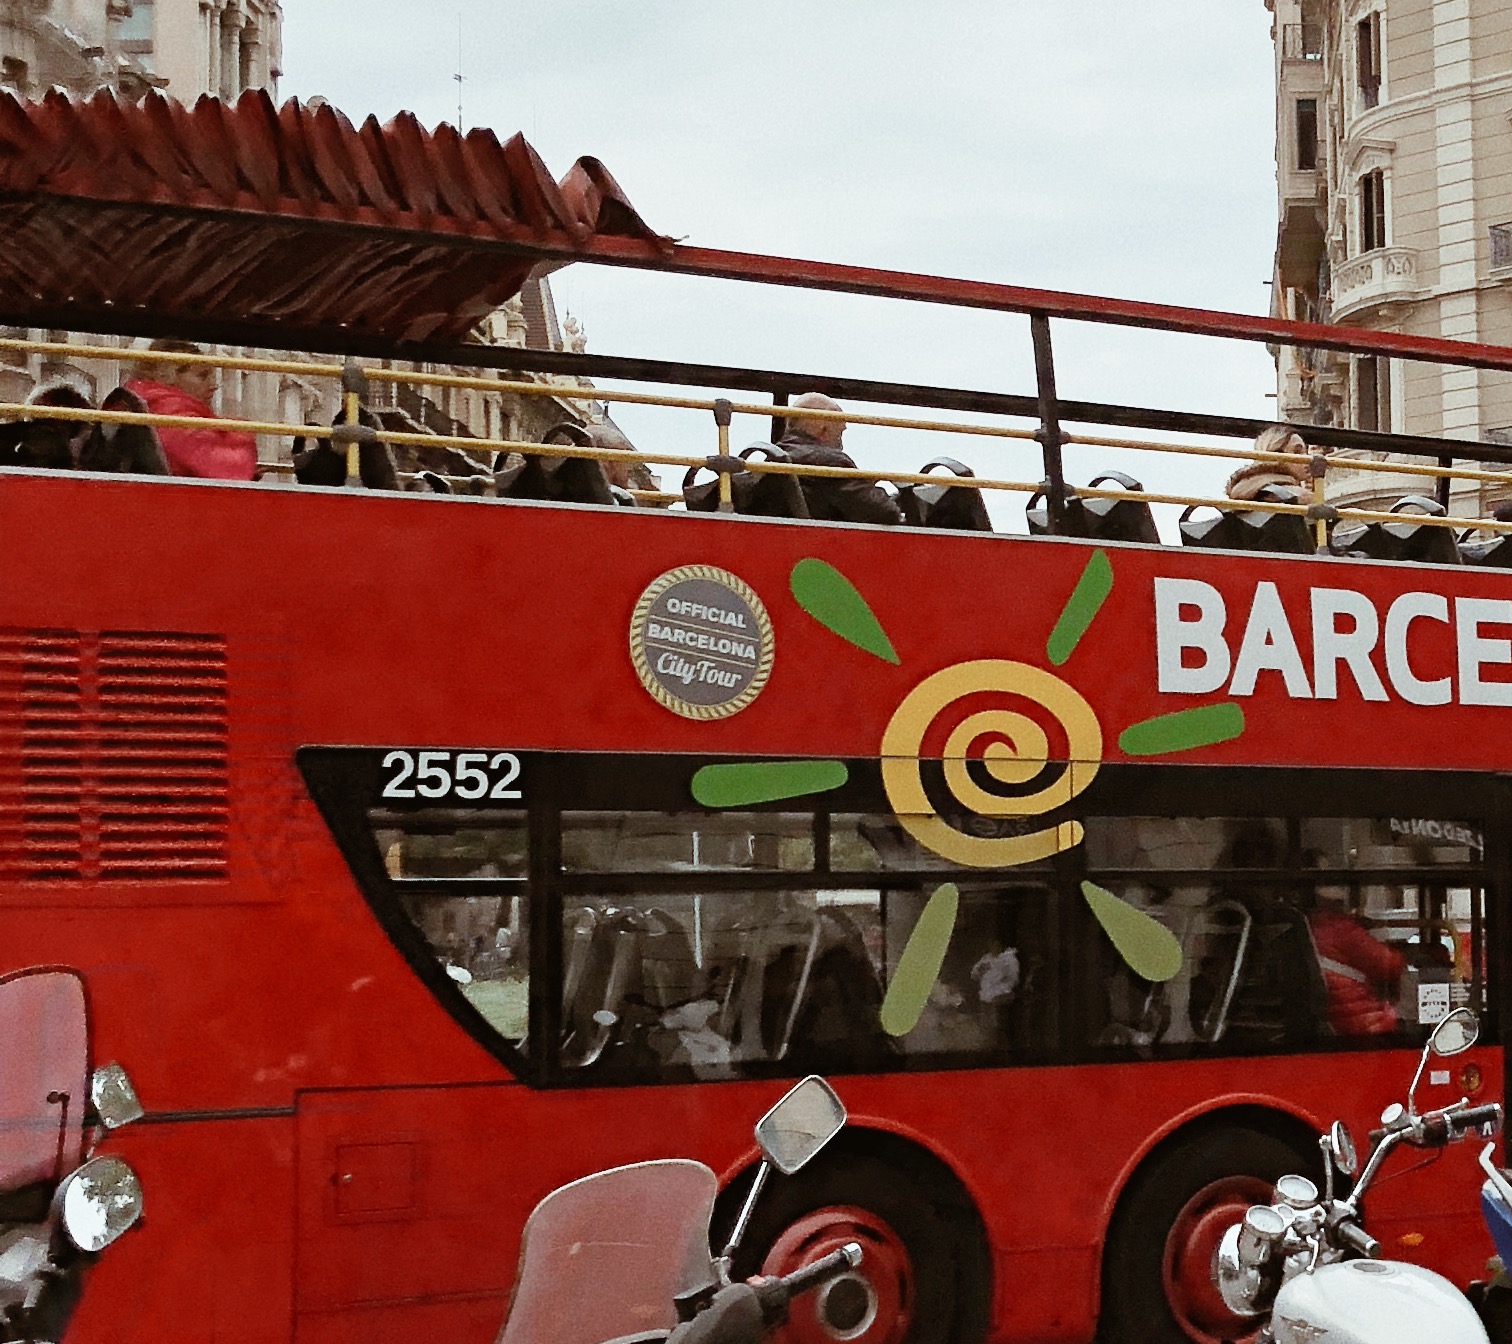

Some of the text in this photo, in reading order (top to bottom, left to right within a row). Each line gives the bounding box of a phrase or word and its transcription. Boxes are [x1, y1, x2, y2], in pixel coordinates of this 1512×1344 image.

[666, 597, 747, 629] OFFICIAL
[647, 622, 757, 660] BARCELONA
[381, 750, 522, 799] 2552
